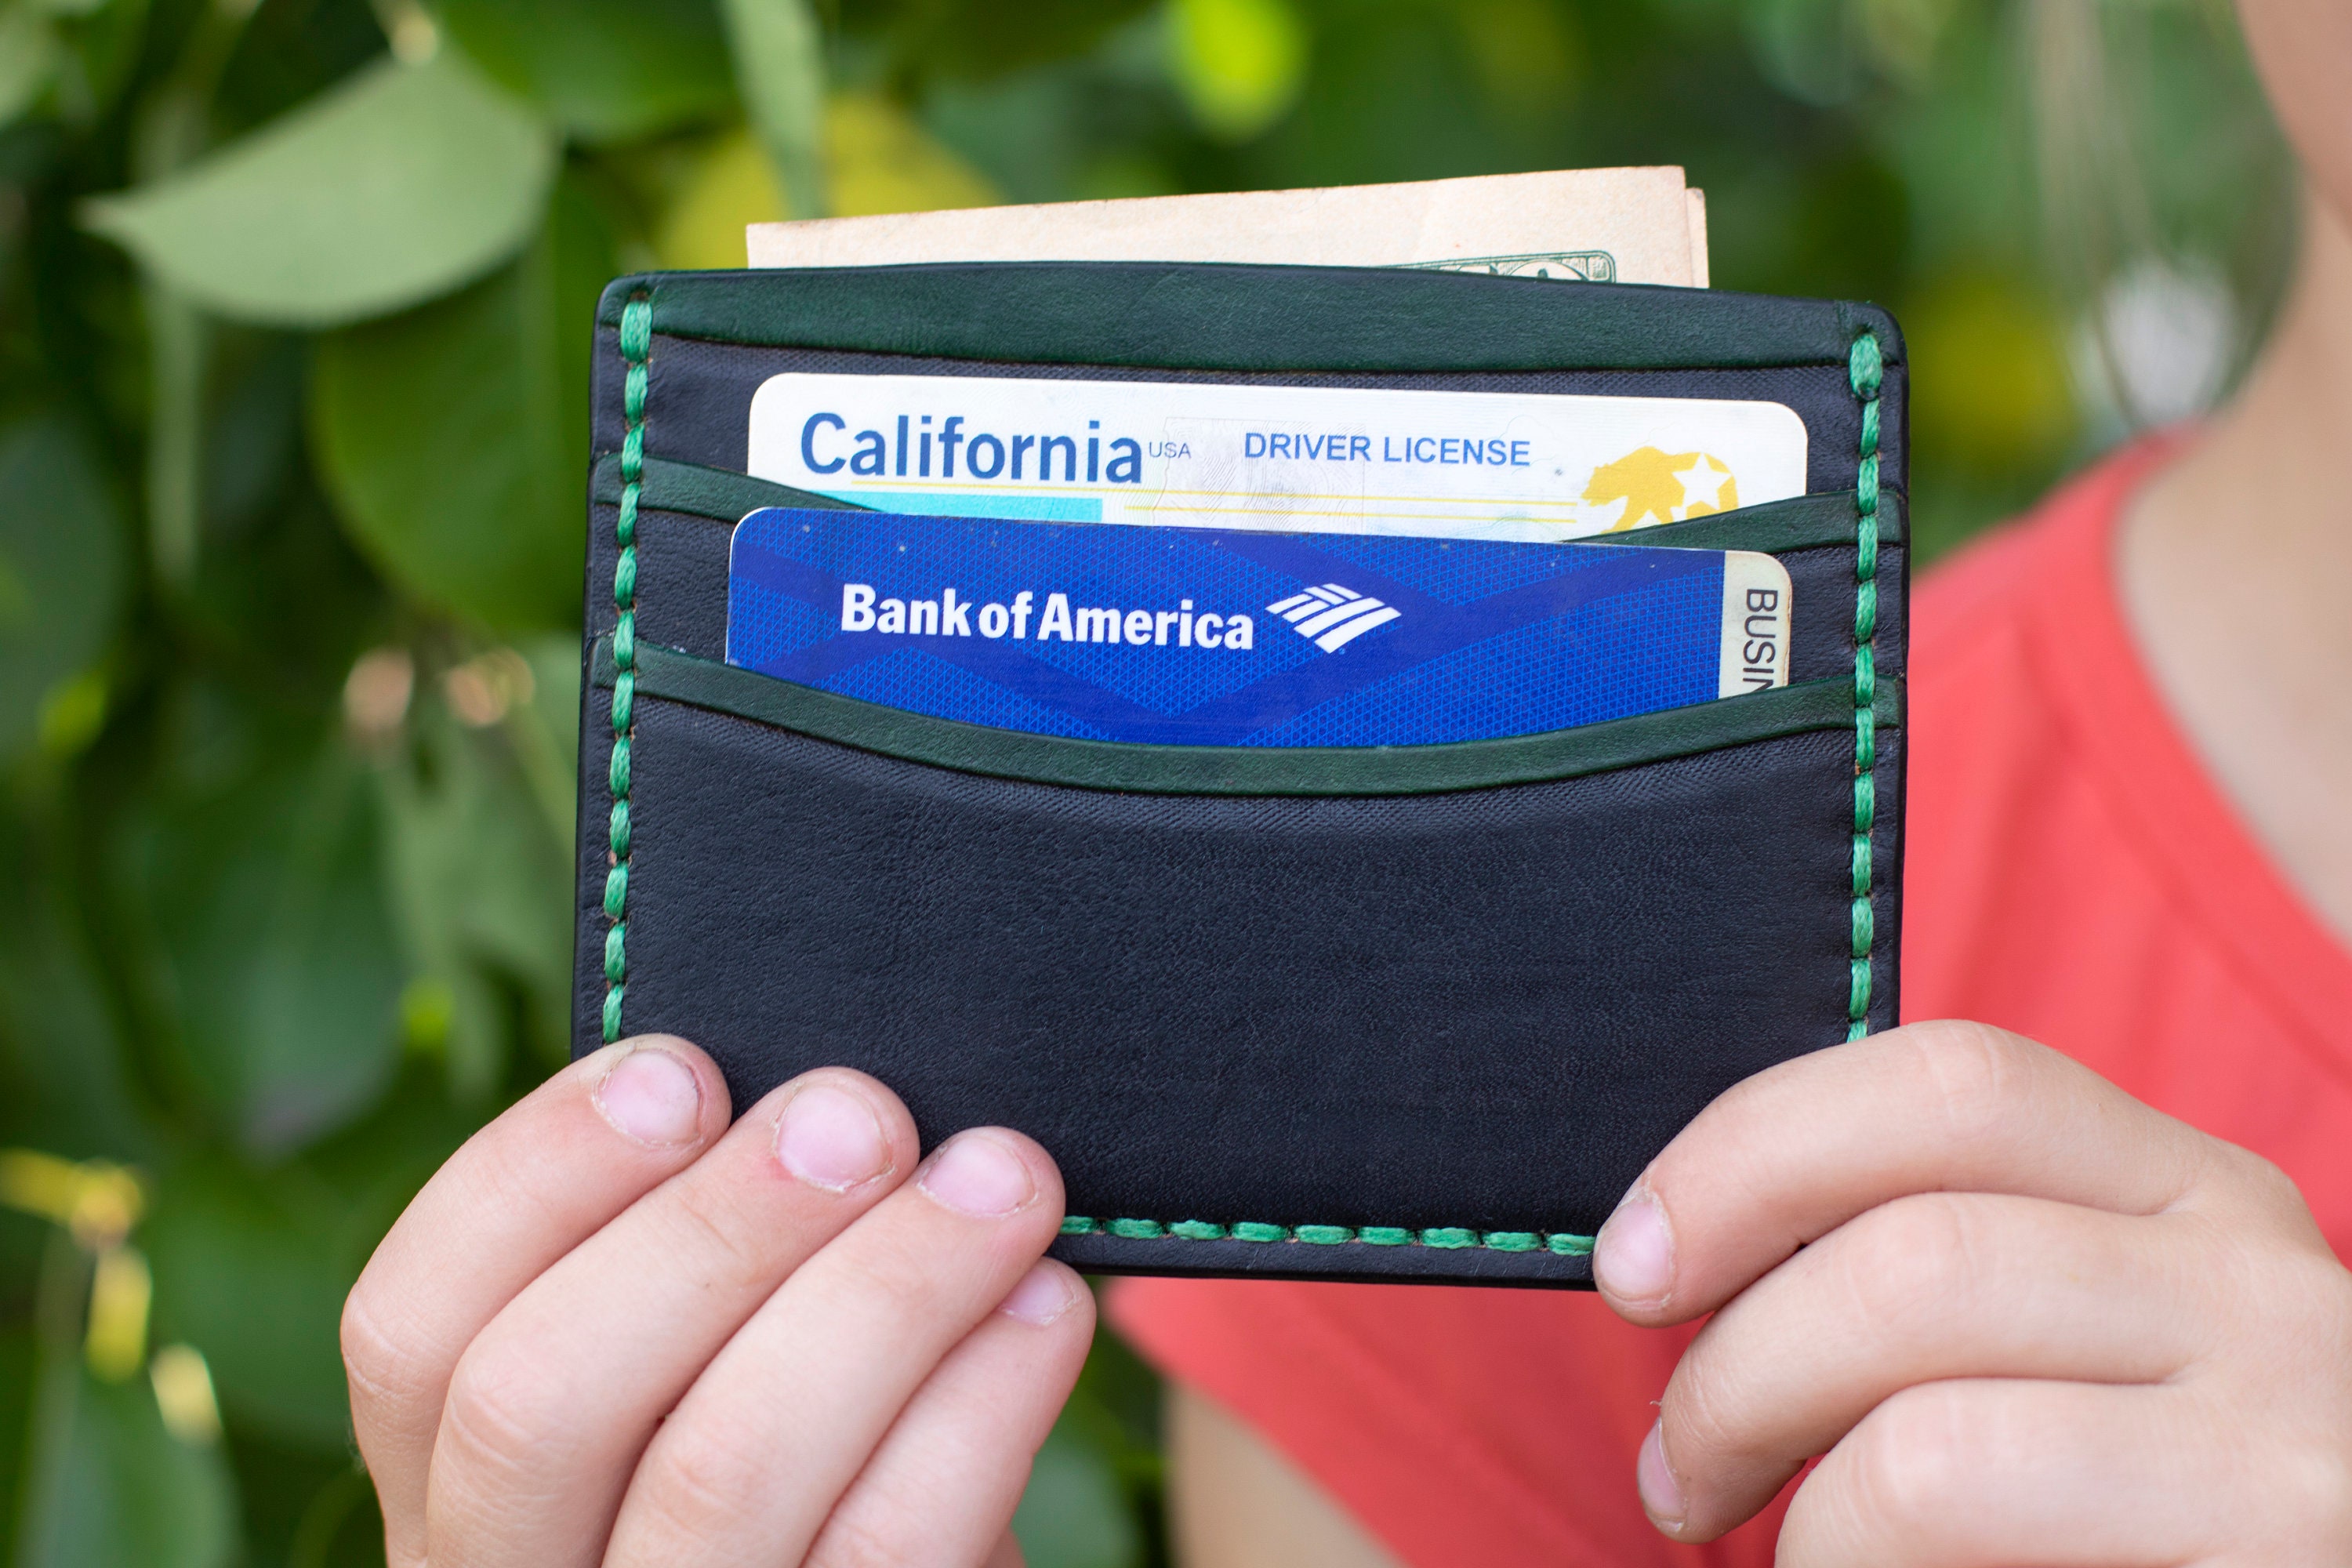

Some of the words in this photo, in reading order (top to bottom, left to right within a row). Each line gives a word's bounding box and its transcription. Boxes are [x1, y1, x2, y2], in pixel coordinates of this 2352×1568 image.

[800, 412, 1142, 484] California
[1149, 441, 1192, 459] USA
[1244, 432, 1371, 462] DRIVER
[1384, 436, 1530, 466] LICENSE
[841, 583, 971, 636] Bank
[978, 590, 1033, 639] of
[1036, 593, 1254, 650] America
